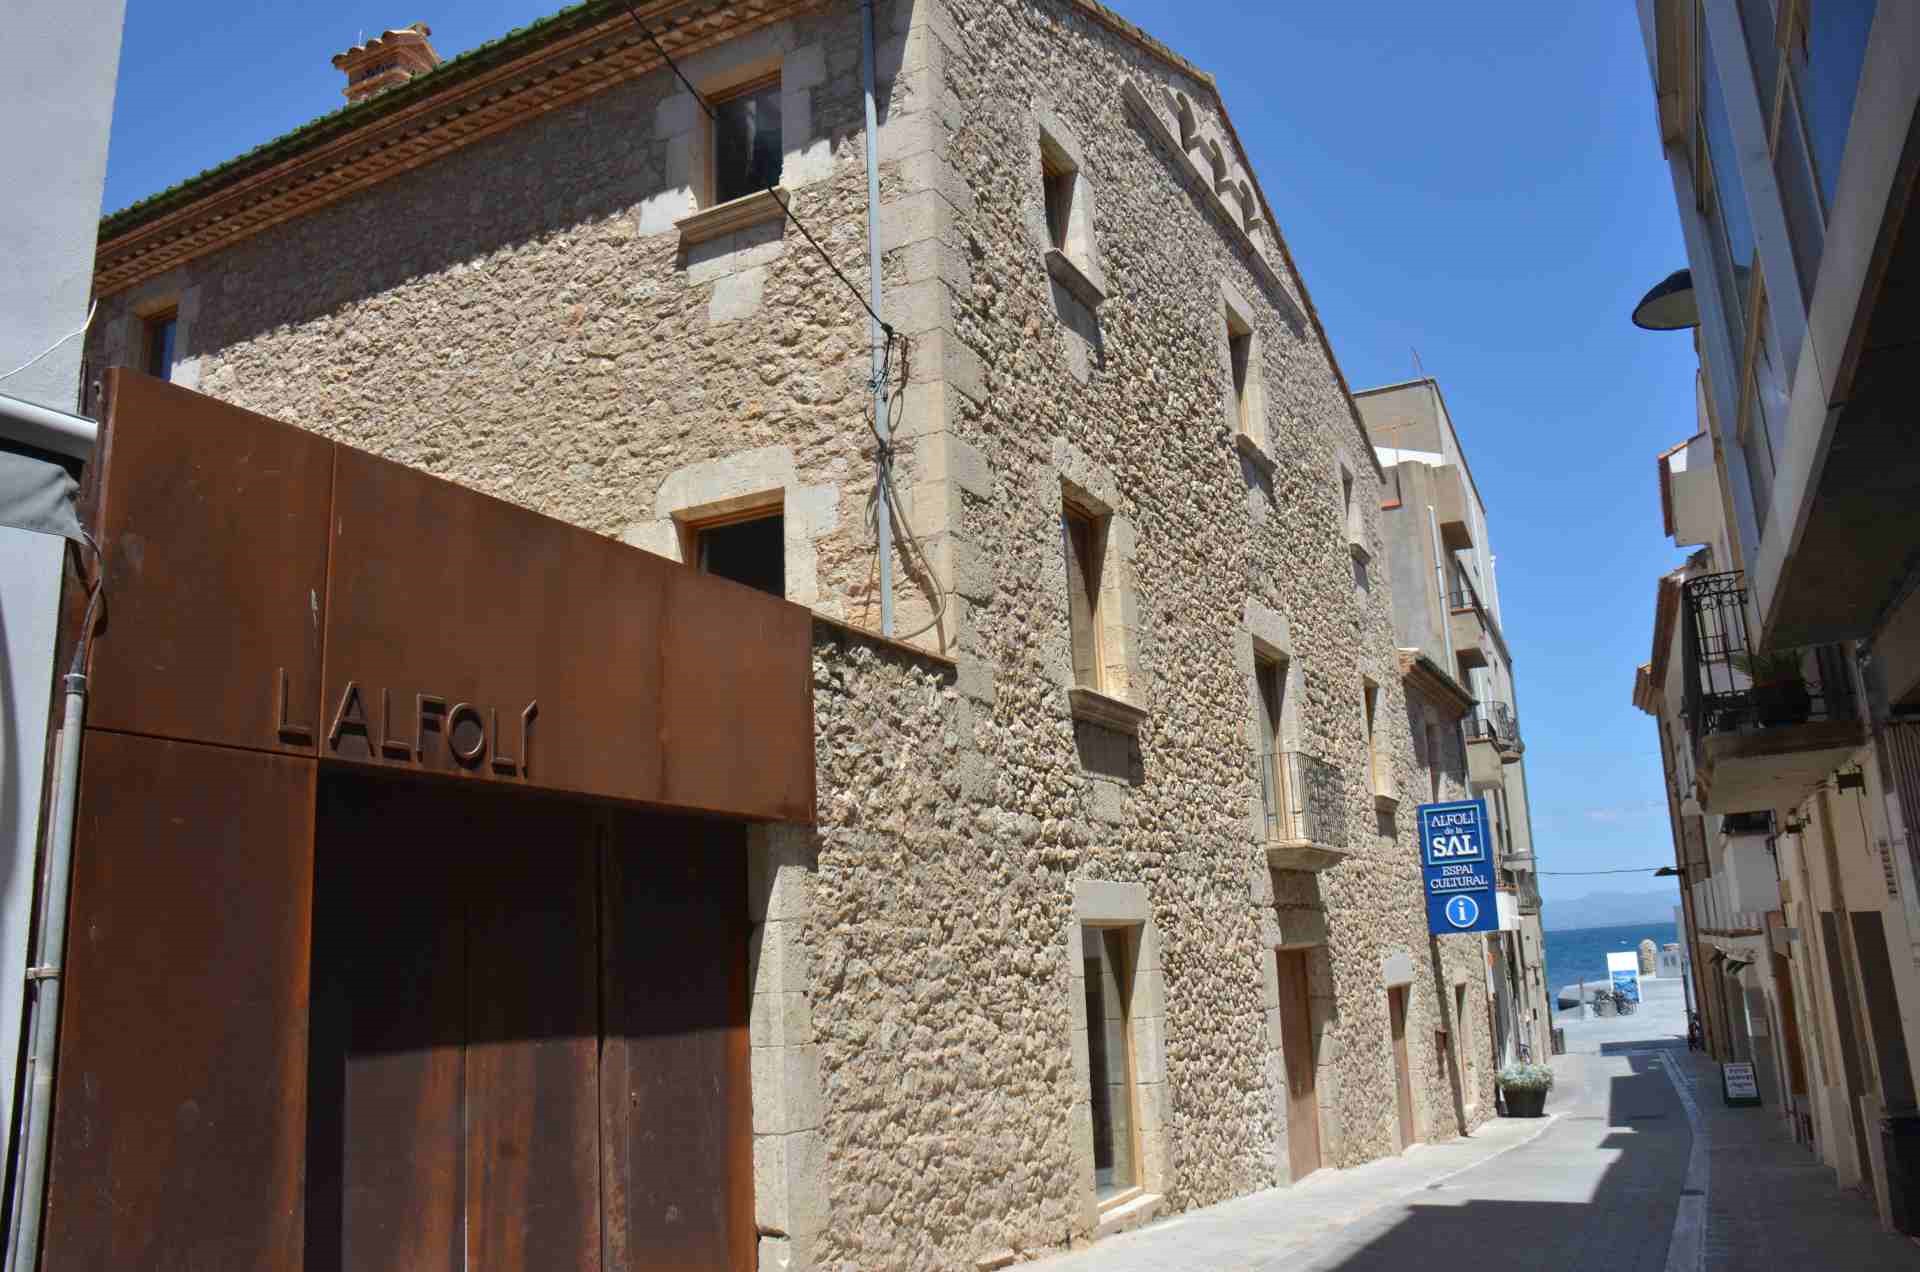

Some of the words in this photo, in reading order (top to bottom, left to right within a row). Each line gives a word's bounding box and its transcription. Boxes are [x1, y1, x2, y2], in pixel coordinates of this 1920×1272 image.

[1444, 827, 1454, 835] de
[1432, 834, 1478, 857] SAL
[1442, 864, 1473, 876] ESPAI
[1430, 875, 1488, 889] CULTURAL
